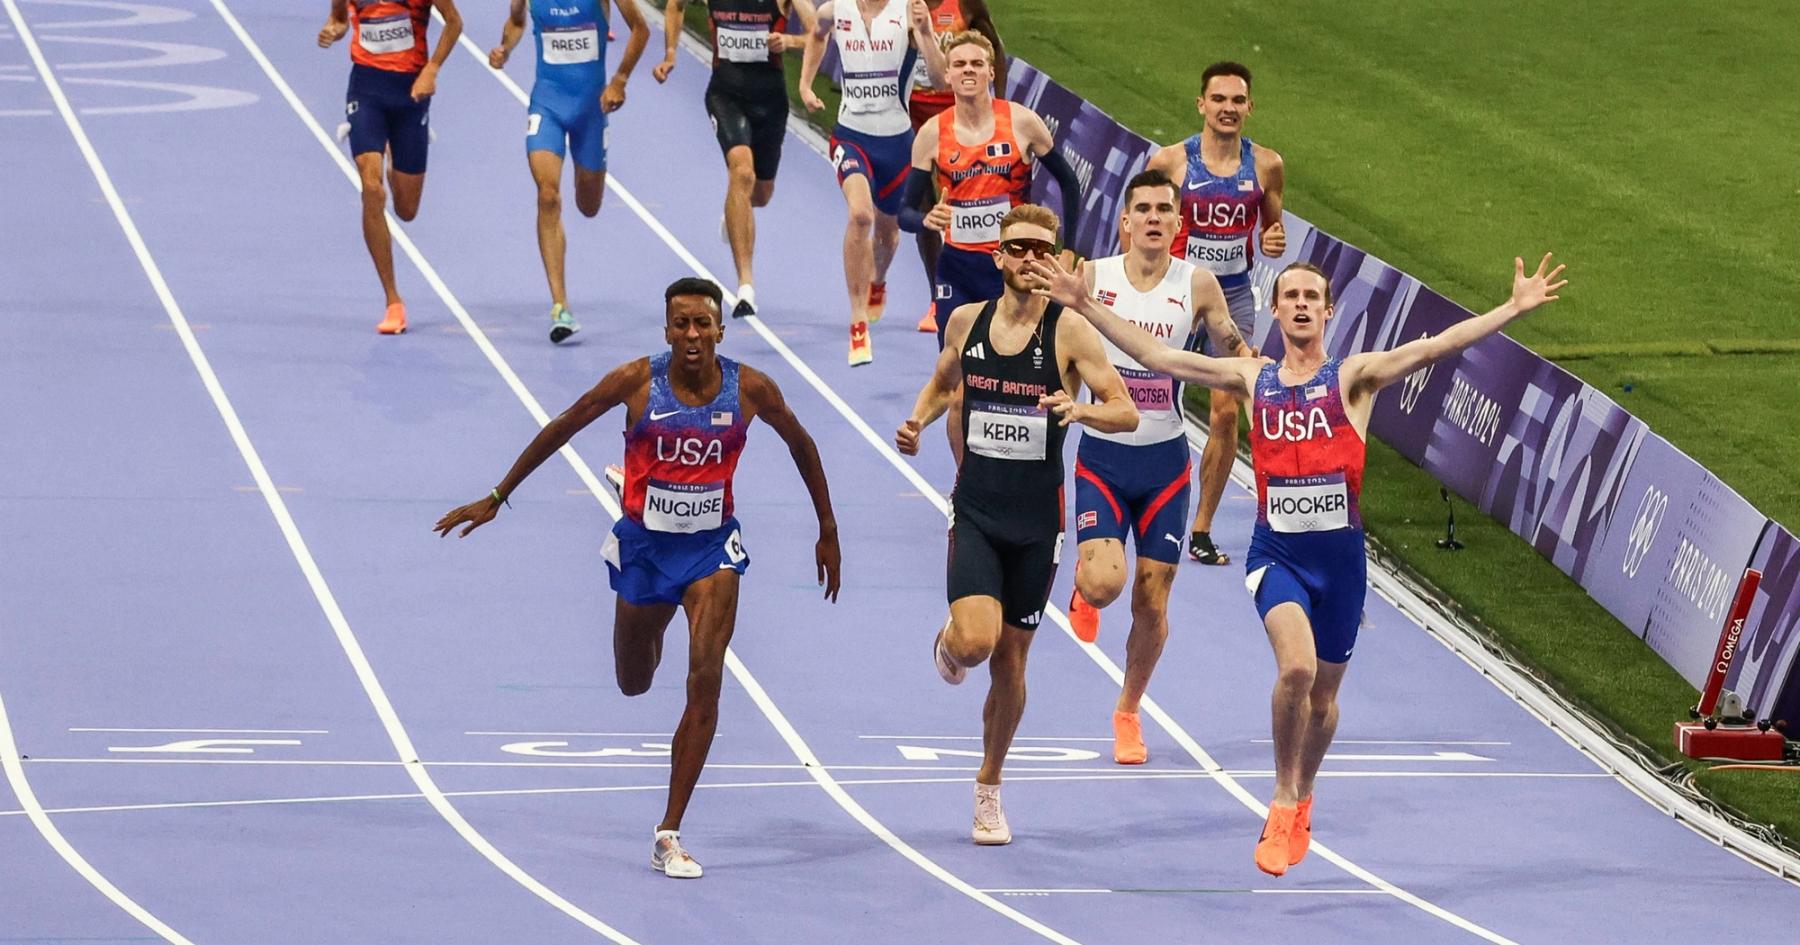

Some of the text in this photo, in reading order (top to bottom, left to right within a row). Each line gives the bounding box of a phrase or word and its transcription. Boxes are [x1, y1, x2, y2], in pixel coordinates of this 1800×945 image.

[549, 7, 580, 17] ITALIA
[551, 37, 591, 51] ARESE
[846, 83, 898, 99] NORDAS
[956, 211, 1005, 230] LAROS
[1193, 202, 1247, 227] USA
[1187, 243, 1244, 261] KESSLER
[966, 374, 1047, 396] GREAT BRITAIN
[1444, 377, 1502, 447] PARIS 2024
[983, 422, 1030, 442] KERR
[1262, 406, 1333, 442] USA
[657, 435, 722, 466] USA
[1270, 493, 1346, 515] HOCKER
[731, 540, 740, 555] 6
[1668, 538, 1731, 624] PARIS 2024
[1722, 618, 1745, 660] OMEGA
[500, 741, 673, 757] 3
[896, 745, 1101, 761] 2
